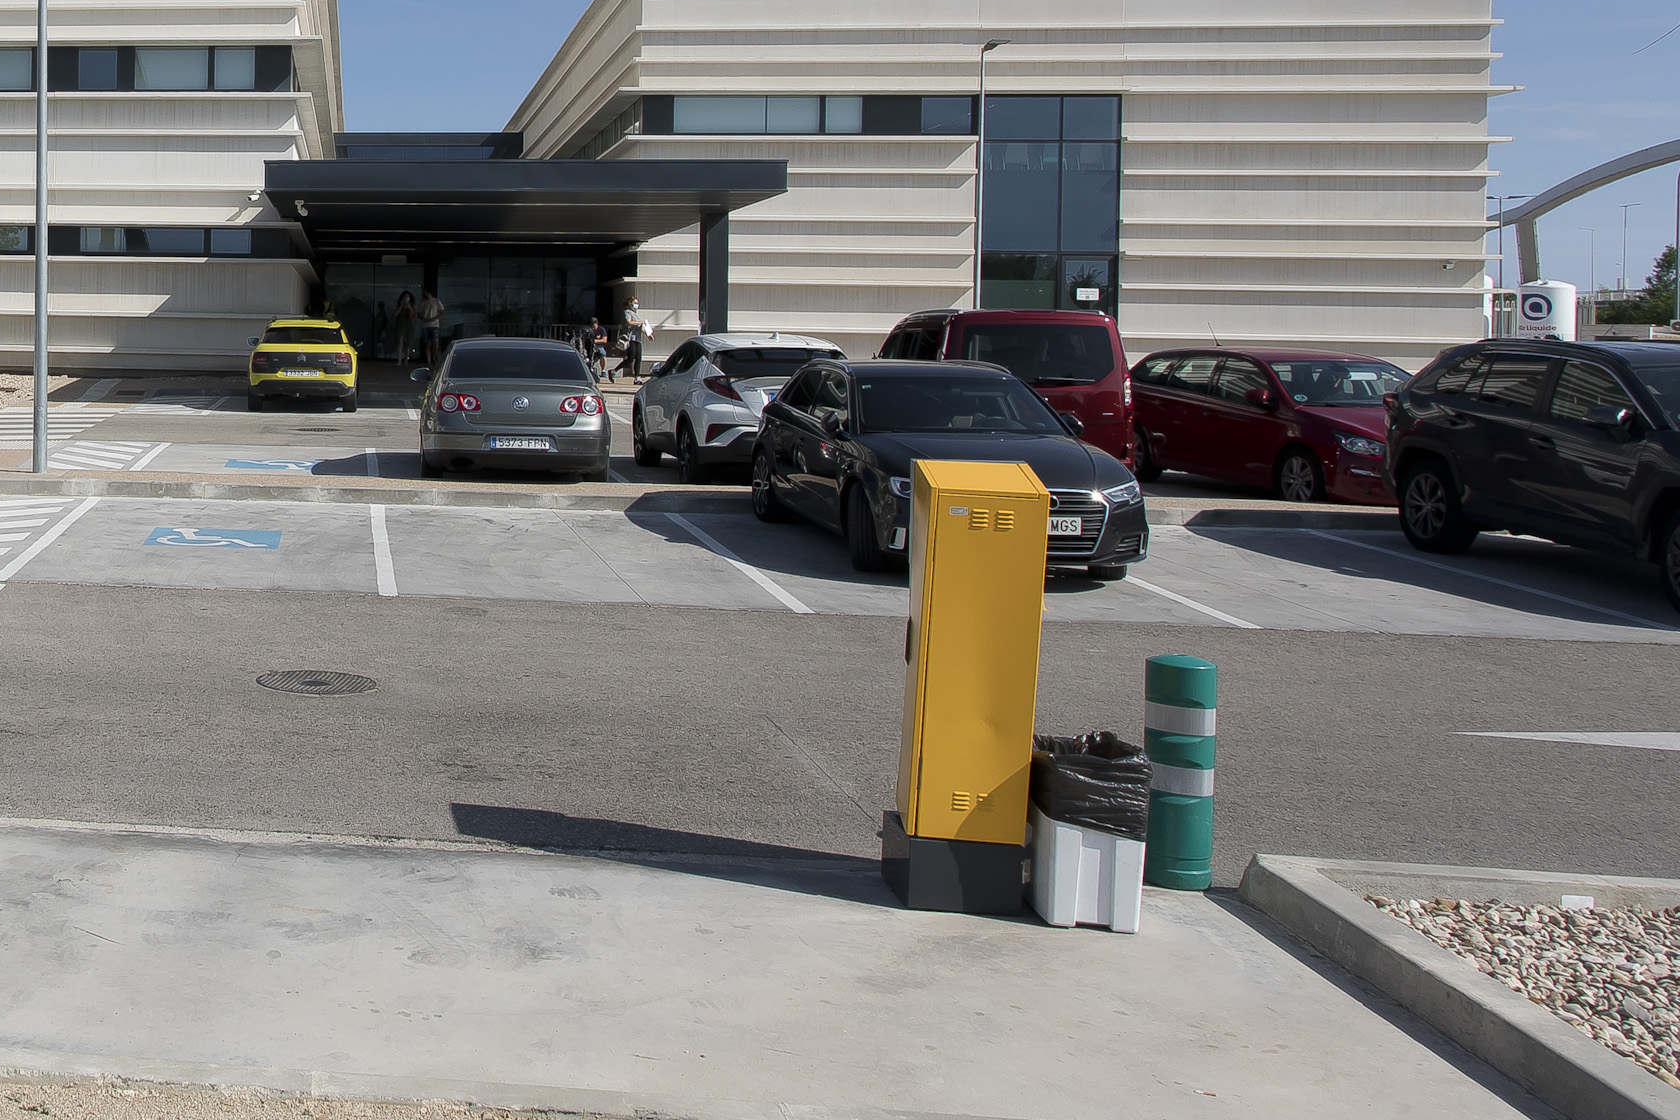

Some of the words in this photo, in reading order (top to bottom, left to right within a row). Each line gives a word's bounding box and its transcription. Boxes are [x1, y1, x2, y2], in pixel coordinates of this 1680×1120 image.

[498, 437, 524, 448] 5373
[527, 437, 547, 448] FPN
[1050, 519, 1078, 532] MGS
